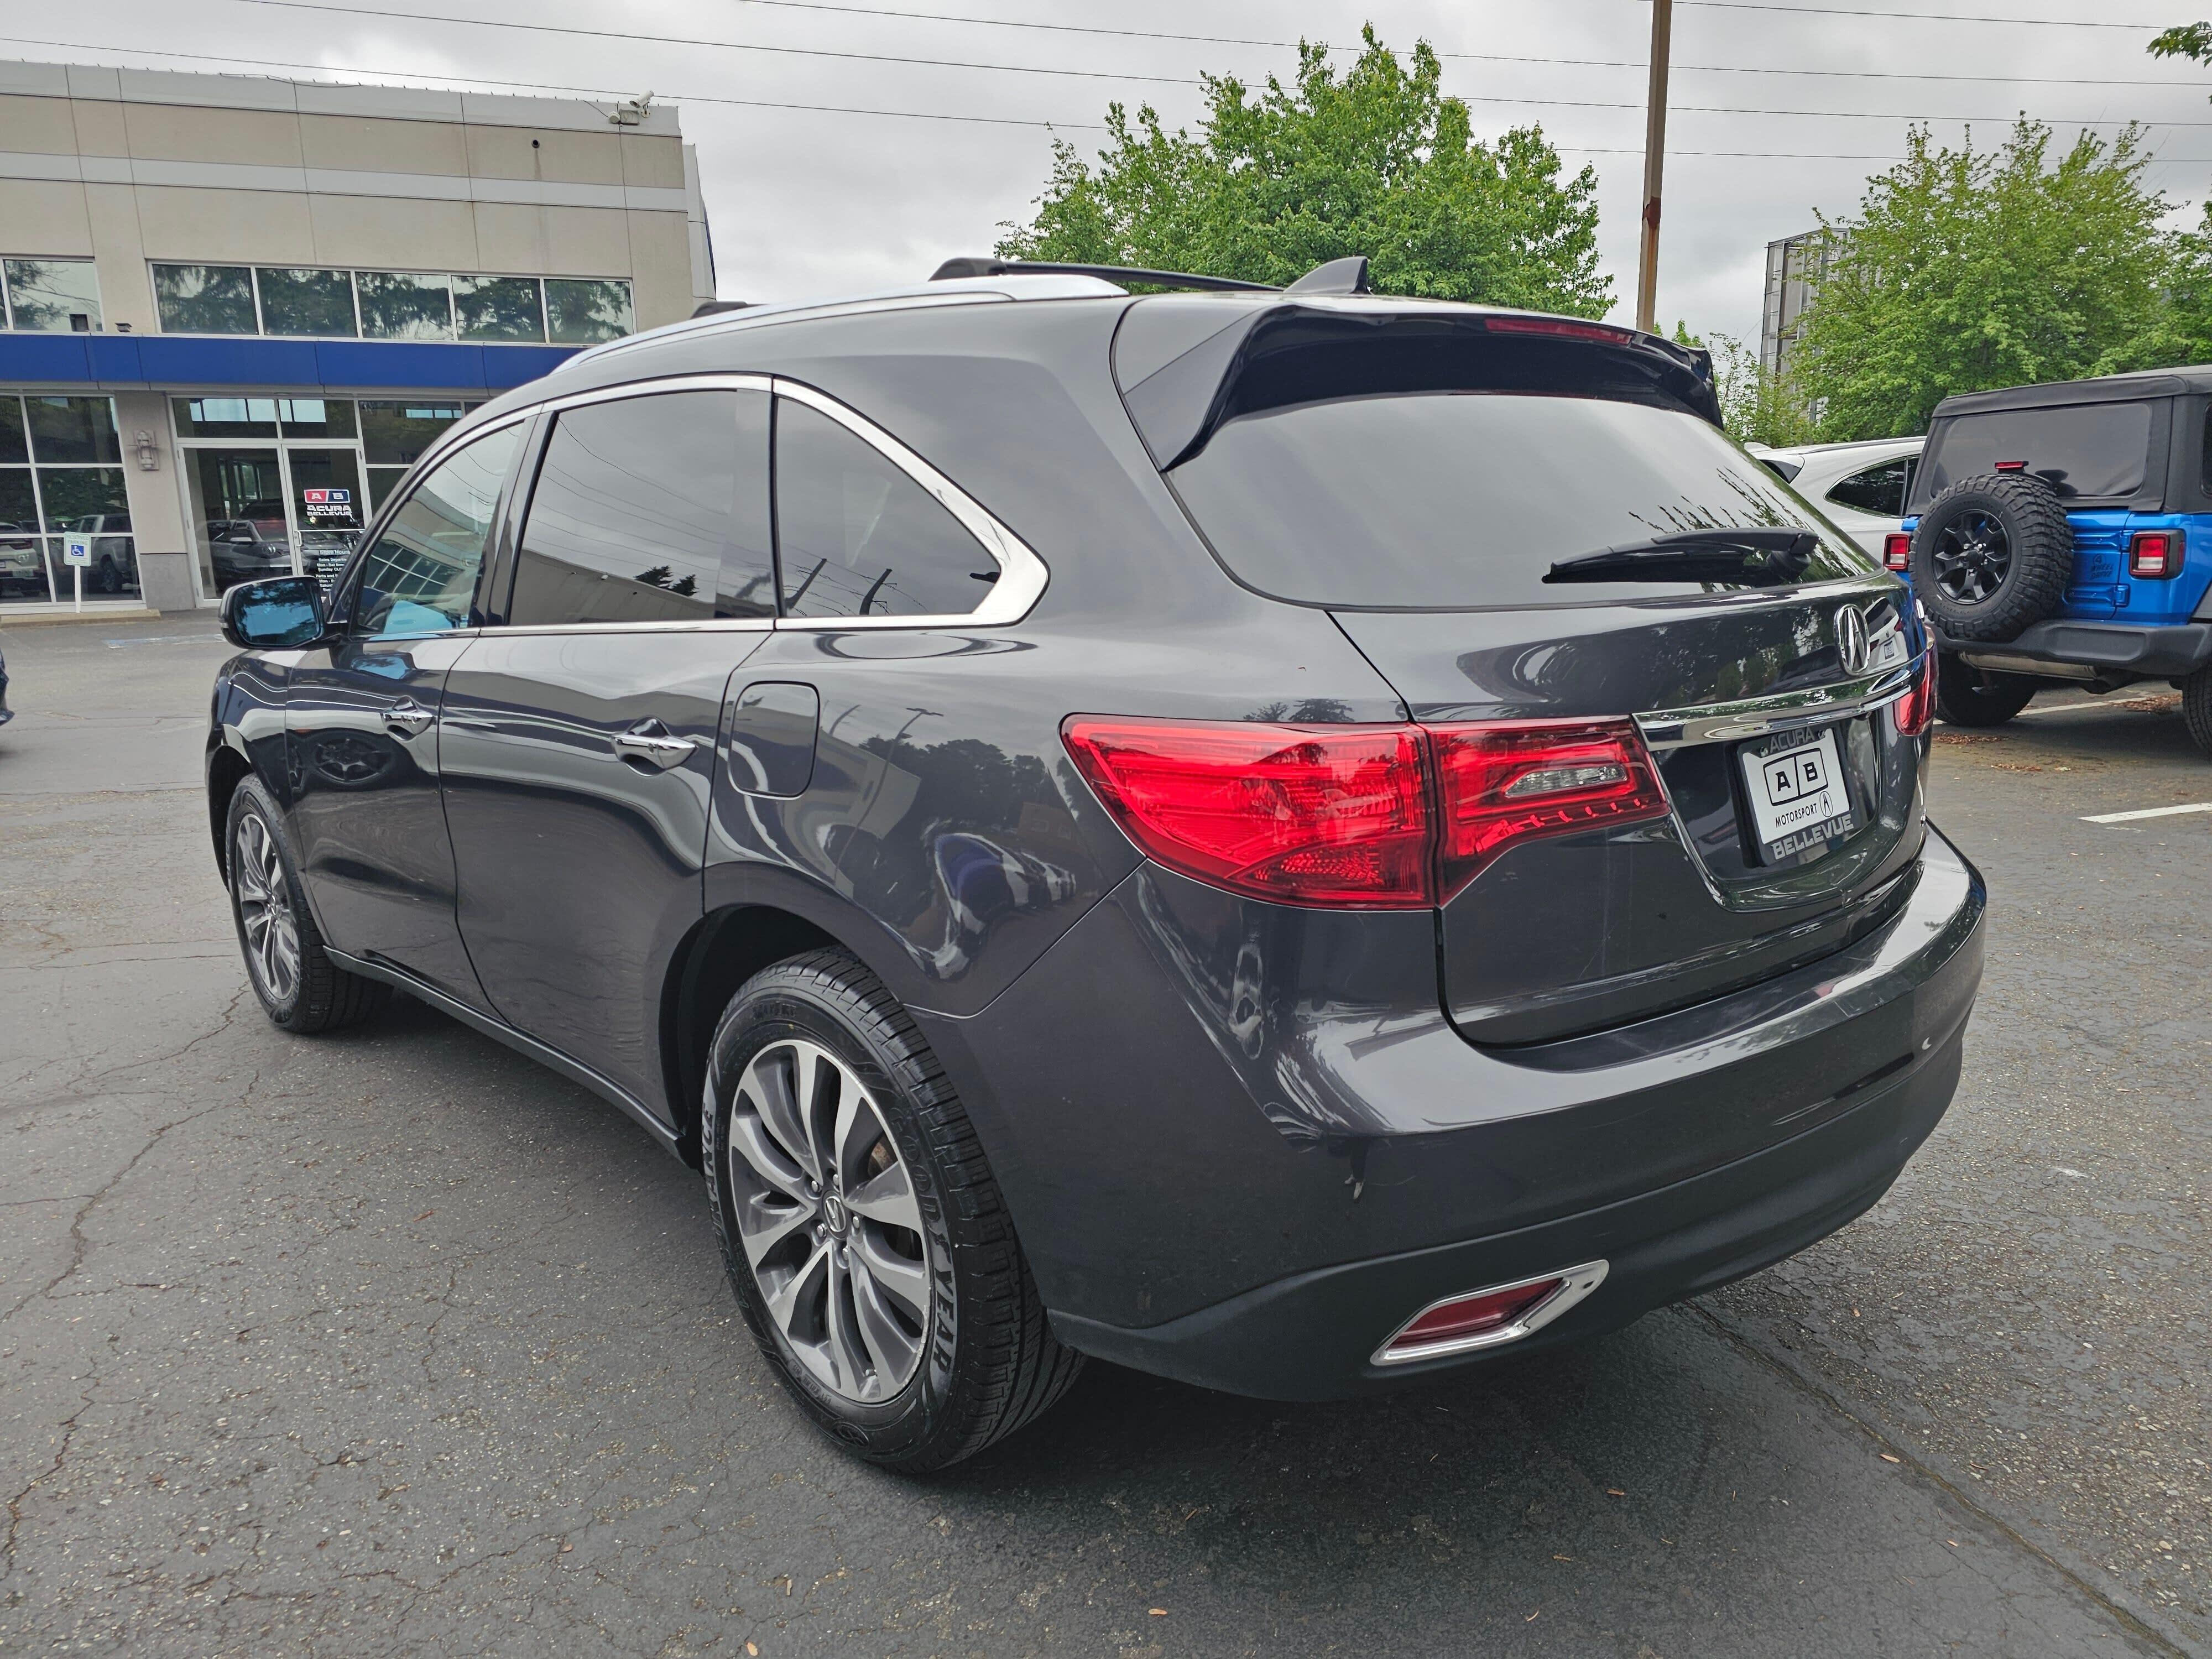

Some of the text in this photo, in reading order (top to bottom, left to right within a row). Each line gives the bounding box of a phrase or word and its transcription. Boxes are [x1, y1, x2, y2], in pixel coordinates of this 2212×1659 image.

[1770, 727, 1815, 753] ACURA
[1776, 761, 1818, 792] A B
[1775, 803, 1818, 828] MOTORSPORT
[1771, 813, 1854, 860] BELLEVUE
